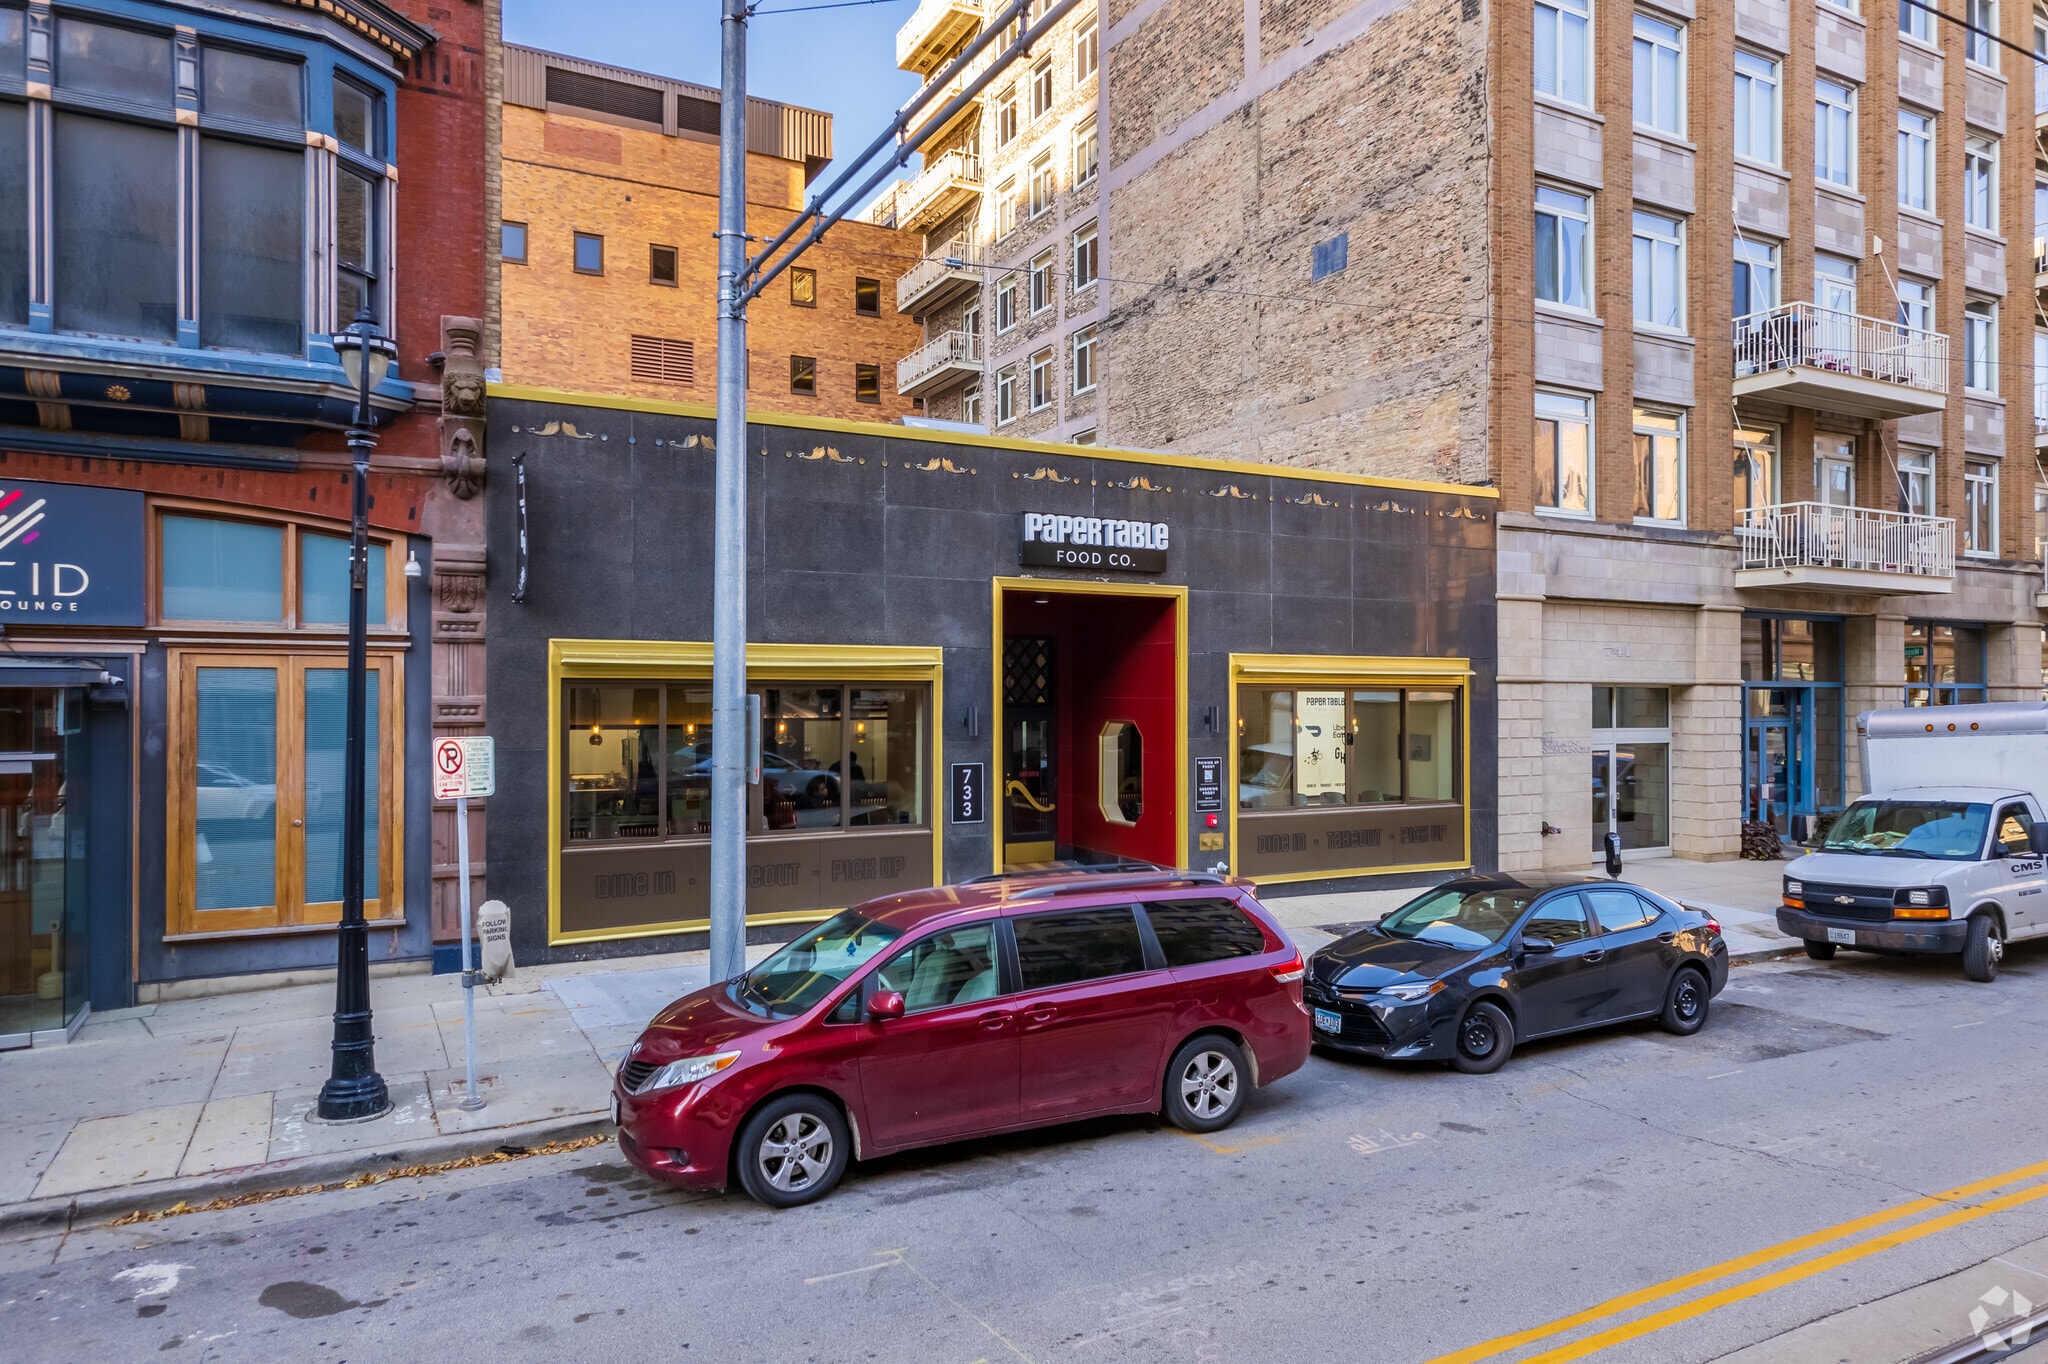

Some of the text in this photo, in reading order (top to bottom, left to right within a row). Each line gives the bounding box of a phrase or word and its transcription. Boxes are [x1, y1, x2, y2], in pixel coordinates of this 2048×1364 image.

[1057, 550, 1136, 567] FOOD CO.
[1603, 644, 1631, 657] 741
[831, 856, 905, 882] PICK UP
[2011, 861, 2043, 873] CMS
[487, 934, 506, 942] SIGNS
